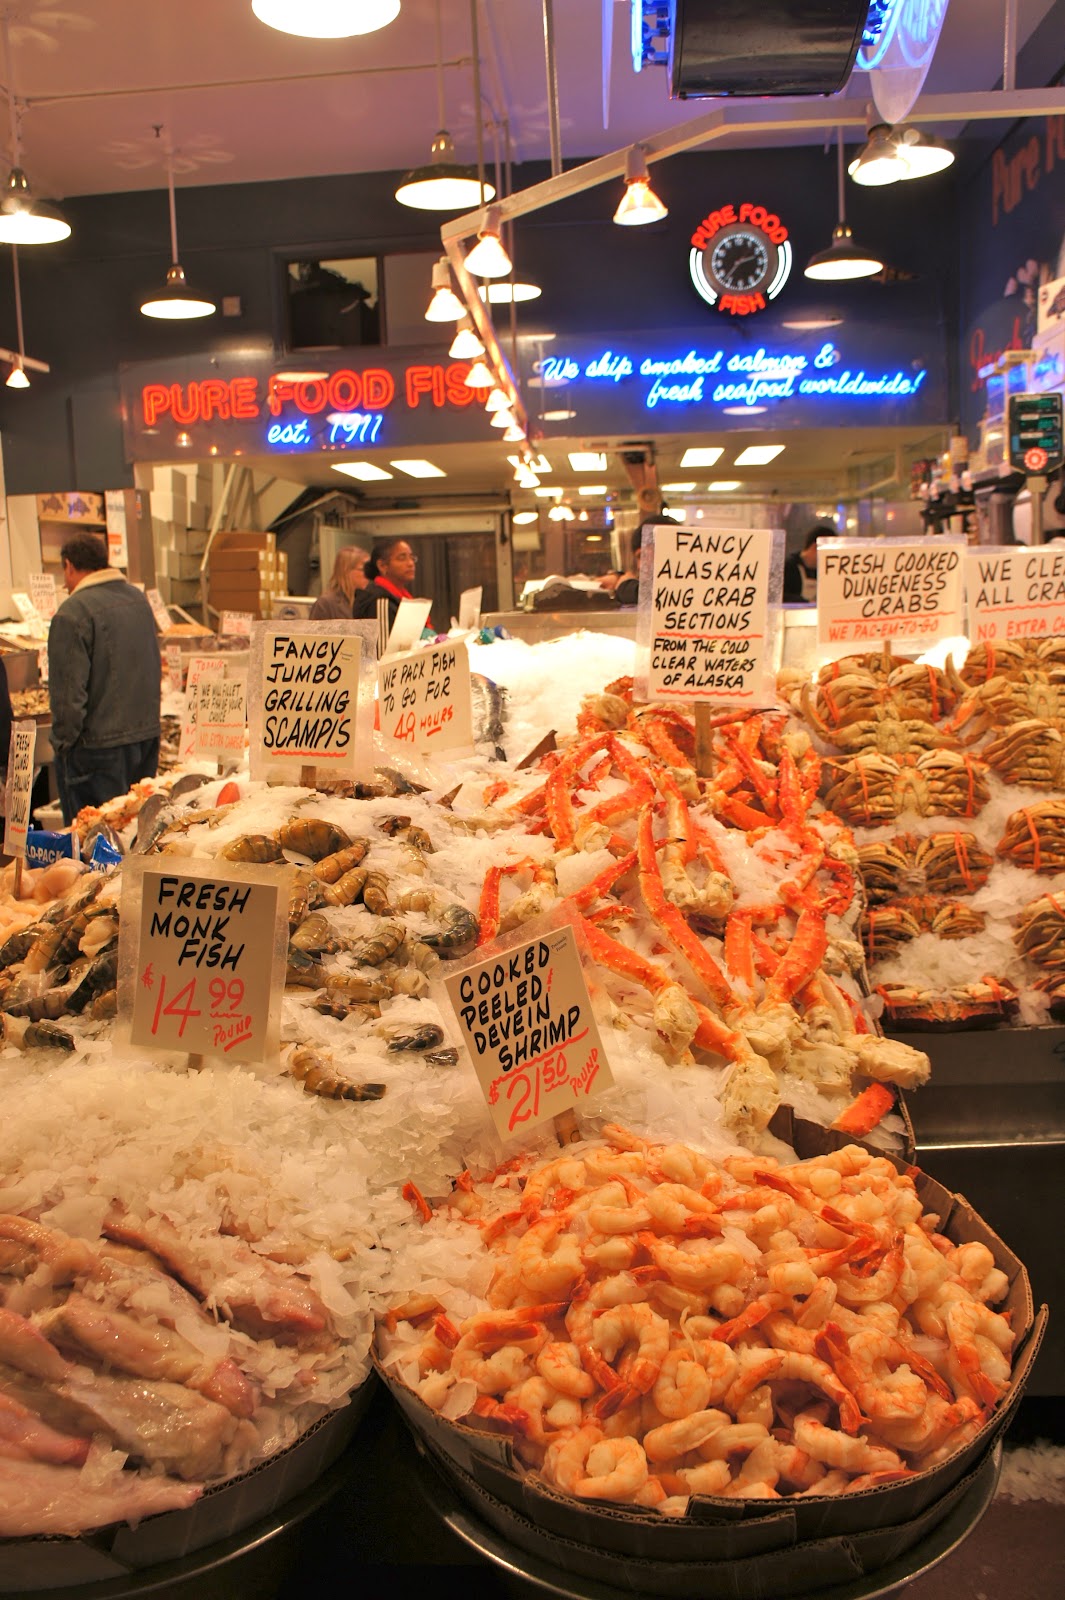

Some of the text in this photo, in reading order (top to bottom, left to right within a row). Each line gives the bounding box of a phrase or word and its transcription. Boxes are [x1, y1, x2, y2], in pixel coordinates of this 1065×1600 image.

[691, 203, 788, 250] PURE FOOD
[718, 291, 766, 315] FISH
[541, 343, 835, 381] We ship smoked salmon &
[142, 362, 489, 425] PURE FOOD FIS
[646, 369, 926, 408] fresh seafood worldwide!
[267, 414, 383, 444] est. 1911
[676, 532, 754, 561] FANCY
[657, 559, 759, 581] ALASKAN
[825, 551, 959, 576] FRESH COOKED
[978, 556, 1065, 583] WE CLE
[655, 586, 756, 611] KING CRAB
[843, 572, 946, 599] DUNGENESS
[975, 586, 1014, 608] ALL
[862, 592, 939, 618] CRABS
[664, 611, 752, 631] SECTIONS
[828, 625, 849, 641] WE
[977, 622, 996, 640] NO
[1006, 618, 1047, 638] EXTRA
[273, 636, 344, 667] FANCY
[653, 638, 750, 655] FROM THE COLD
[266, 663, 342, 685] JUMBO
[383, 650, 456, 692] WE PACK FISH
[652, 656, 756, 673] CLEAR WATERS
[202, 684, 211, 697] WE
[663, 673, 744, 689] OF ALASKA
[265, 689, 349, 714] GRILLING
[384, 676, 450, 716] TO GO FOR
[420, 704, 454, 731] HOURS
[158, 877, 252, 914] FRESH
[150, 911, 231, 942] MONK
[178, 938, 245, 972] FISH
[460, 941, 550, 1003] COOKED
[213, 1015, 252, 1047] POUND
[474, 993, 550, 1055] DEVEIN
[498, 1005, 581, 1072] SHRIMP
[570, 1047, 599, 1098] POUND
